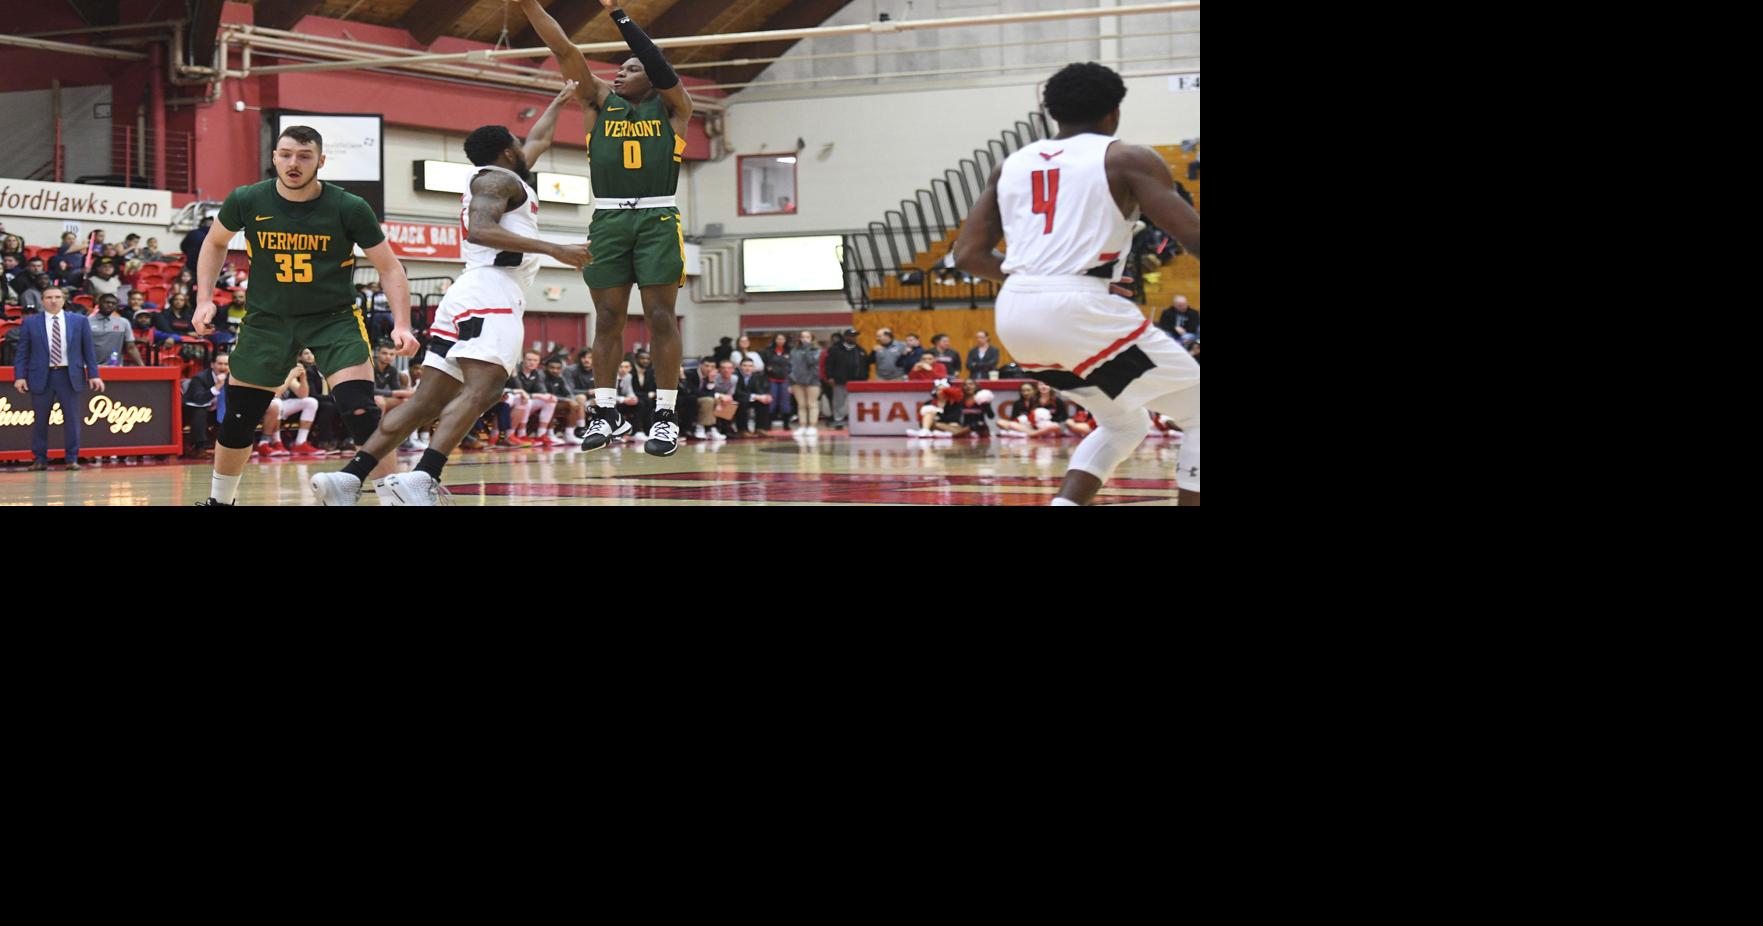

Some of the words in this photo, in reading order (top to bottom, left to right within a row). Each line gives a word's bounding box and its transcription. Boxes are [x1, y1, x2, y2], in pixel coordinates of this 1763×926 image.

[604, 119, 661, 138] VERMONT
[623, 140, 642, 169] 0
[1031, 168, 1060, 235] 4
[256, 231, 331, 252] VERMONT
[430, 226, 457, 246] BAR
[274, 253, 313, 283] 35
[84, 395, 152, 434] Pizza
